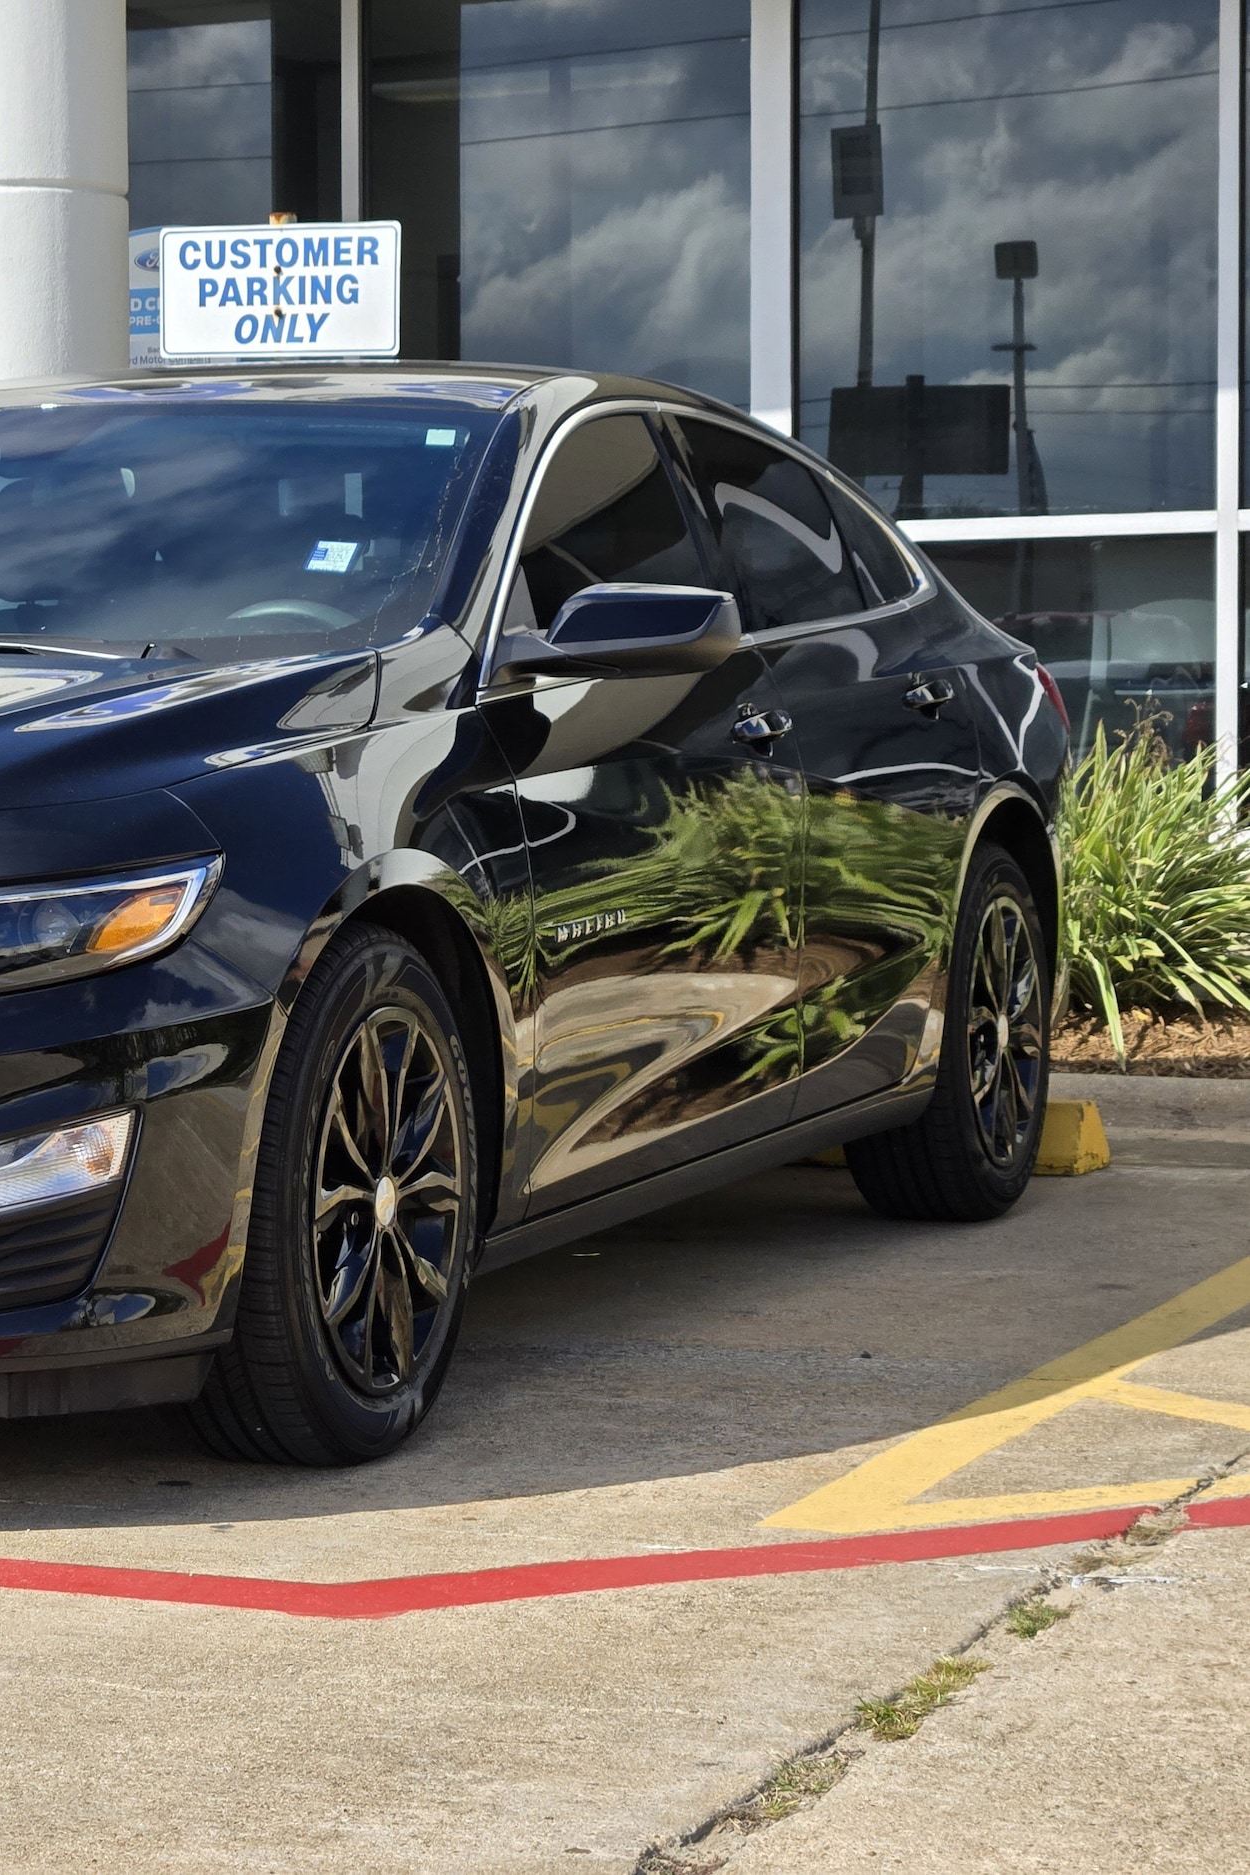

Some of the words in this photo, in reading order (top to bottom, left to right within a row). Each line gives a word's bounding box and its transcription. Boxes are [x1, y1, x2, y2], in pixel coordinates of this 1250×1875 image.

[179, 236, 380, 270] CUSTOMER
[199, 274, 360, 308] PARKING
[234, 312, 331, 344] ONLY
[556, 909, 626, 942] MALIBU
